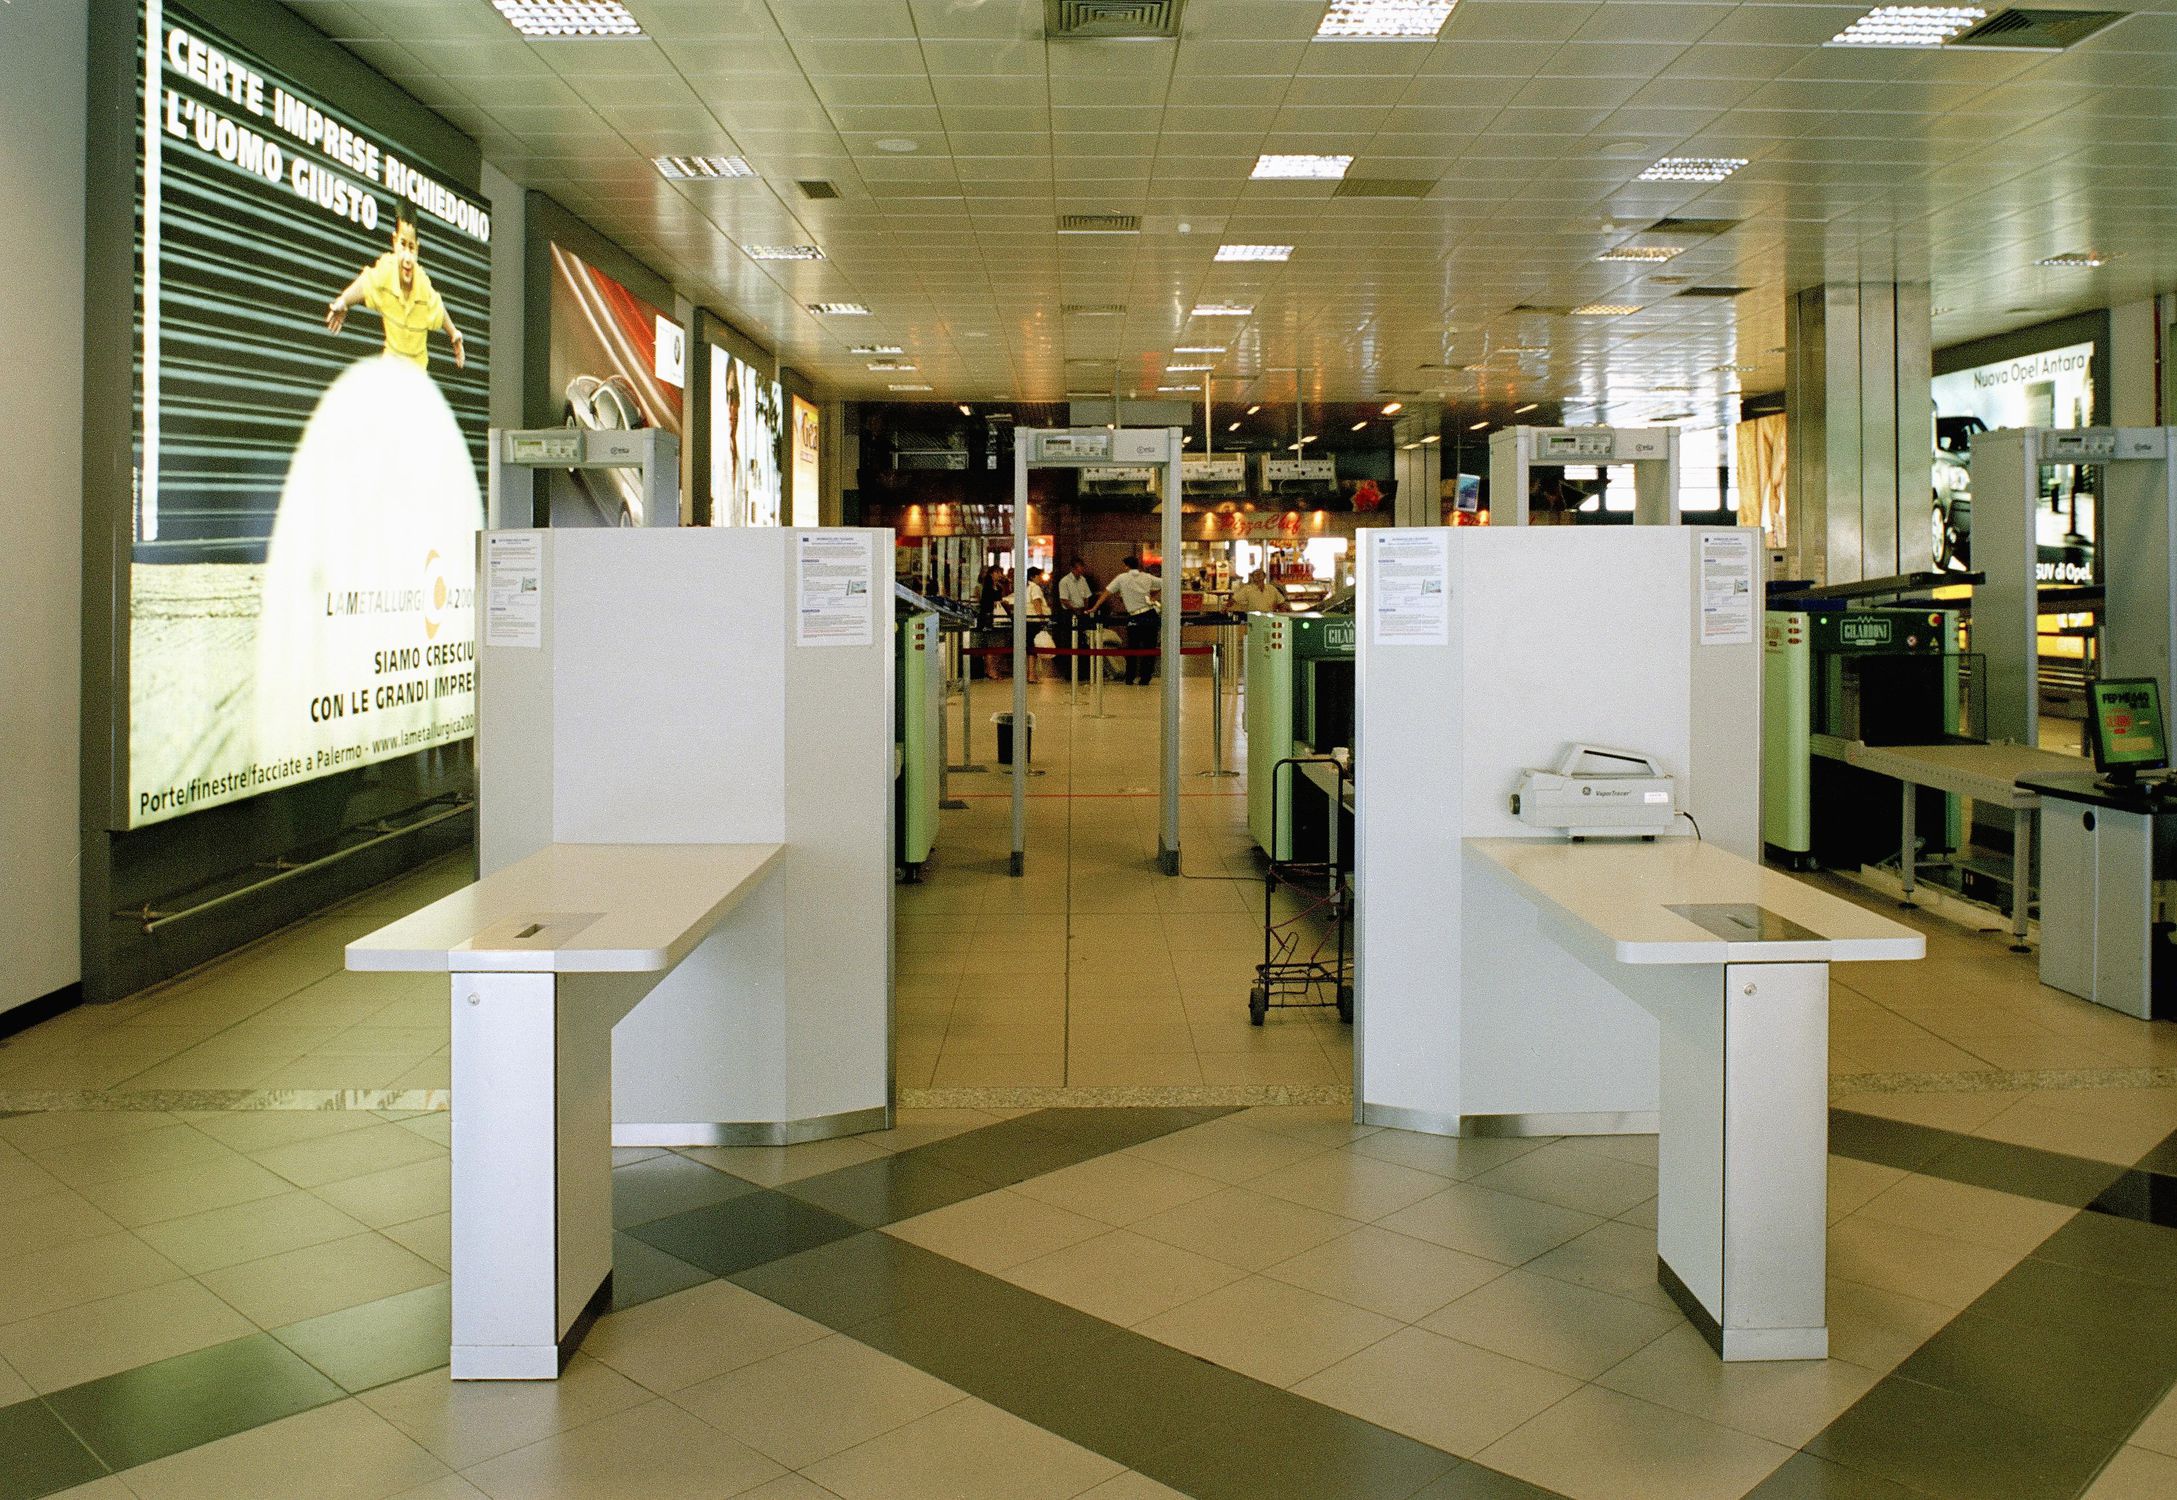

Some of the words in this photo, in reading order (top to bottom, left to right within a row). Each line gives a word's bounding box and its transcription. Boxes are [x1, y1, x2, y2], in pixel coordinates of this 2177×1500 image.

[168, 28, 264, 116] CERTE
[274, 87, 379, 182] IMPRESE
[385, 154, 490, 242] RICHIEDONO
[167, 89, 283, 184] L'UOMO
[291, 157, 378, 230] GIUSTO
[1974, 370, 2008, 390] Nuova
[2011, 357, 2039, 384] Opel
[2042, 355, 2085, 375] Antara
[2055, 561, 2066, 581] di
[374, 647, 421, 675] SIAMO
[311, 693, 344, 722] CON
[352, 689, 369, 715] LE
[376, 679, 429, 709] GRANDI
[306, 756, 313, 771] a
[317, 744, 362, 769] Palermo
